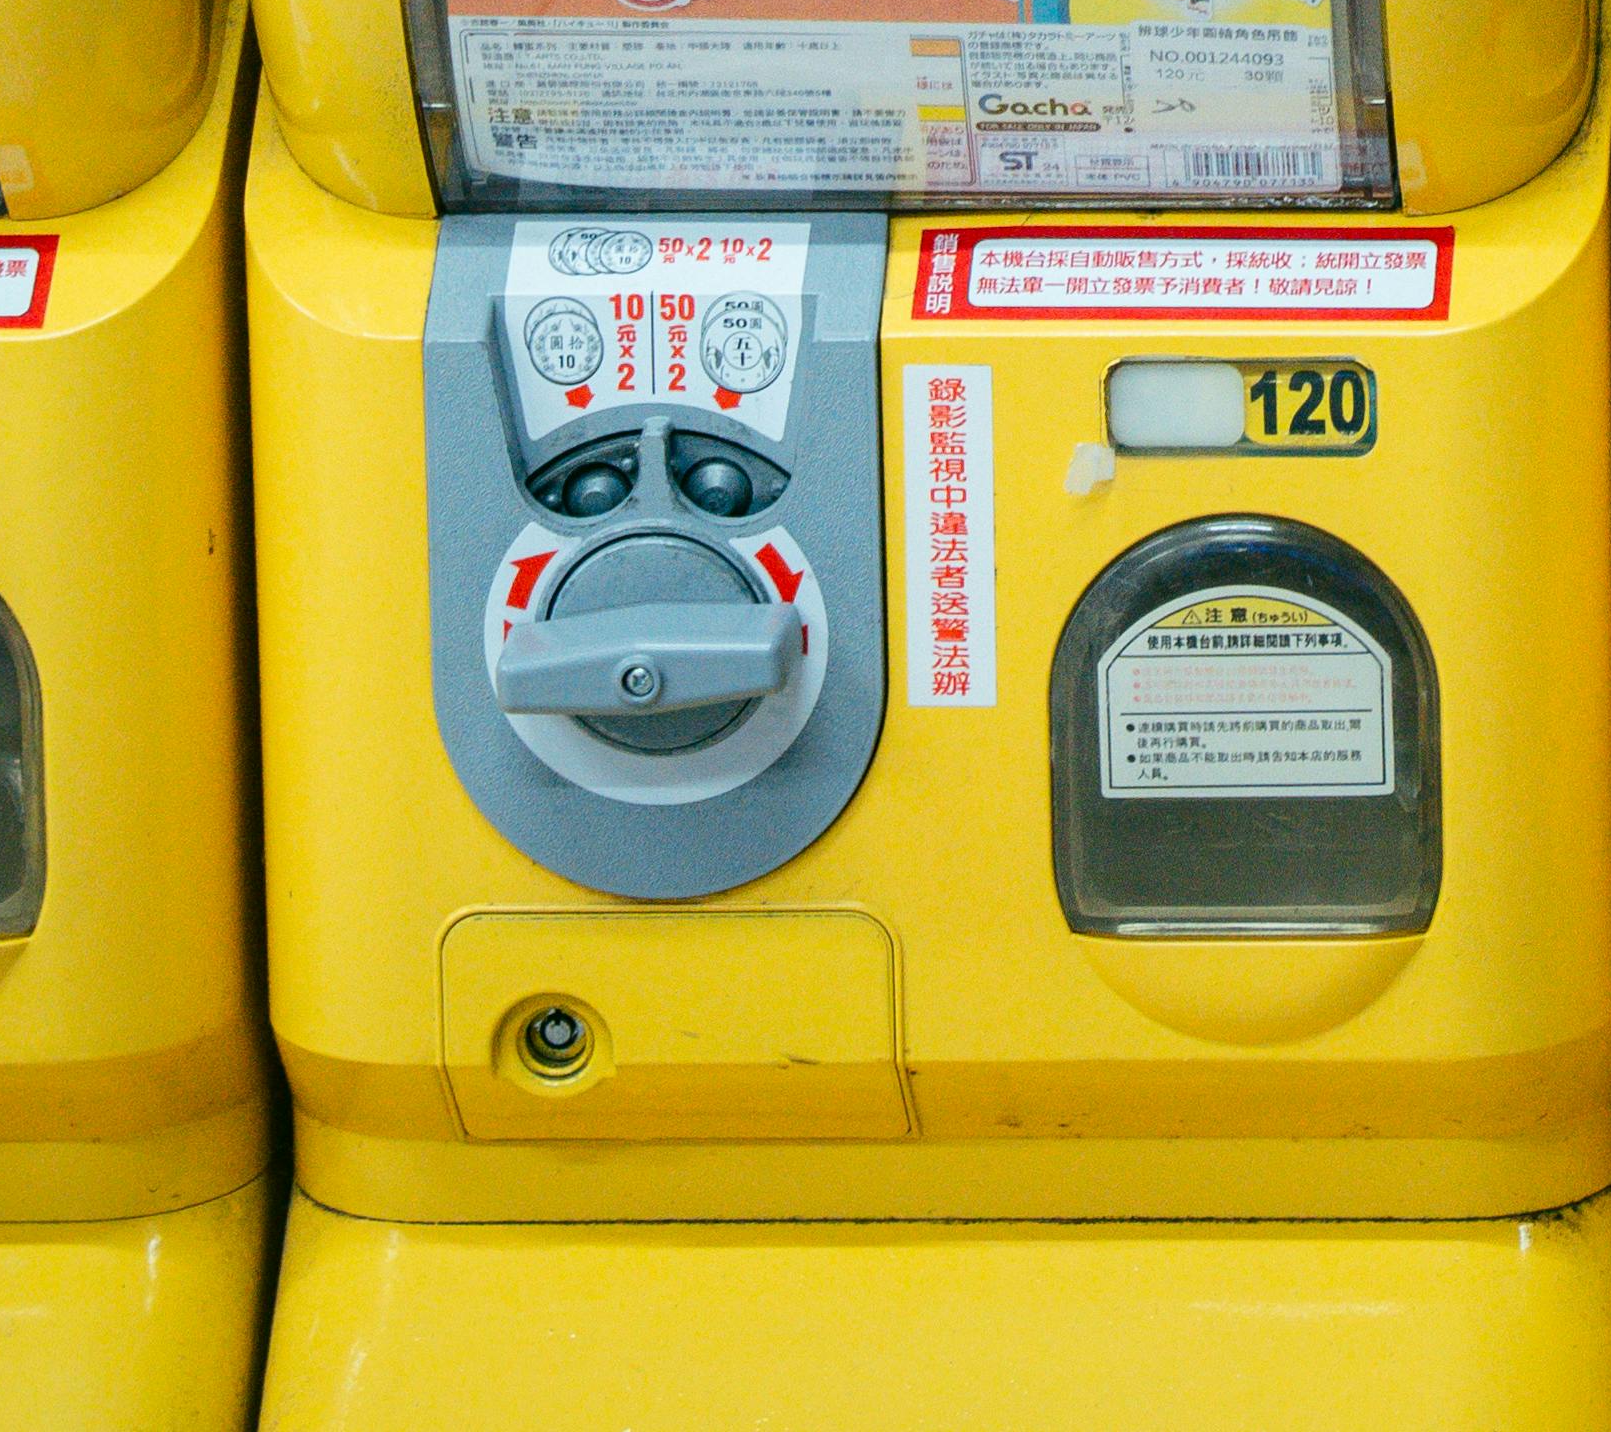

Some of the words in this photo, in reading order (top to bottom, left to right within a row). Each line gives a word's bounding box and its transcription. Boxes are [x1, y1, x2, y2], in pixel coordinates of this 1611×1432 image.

[1148, 49, 1285, 67] NO.001244093
[978, 93, 1092, 116] Gacha
[1250, 369, 1366, 438] 120
